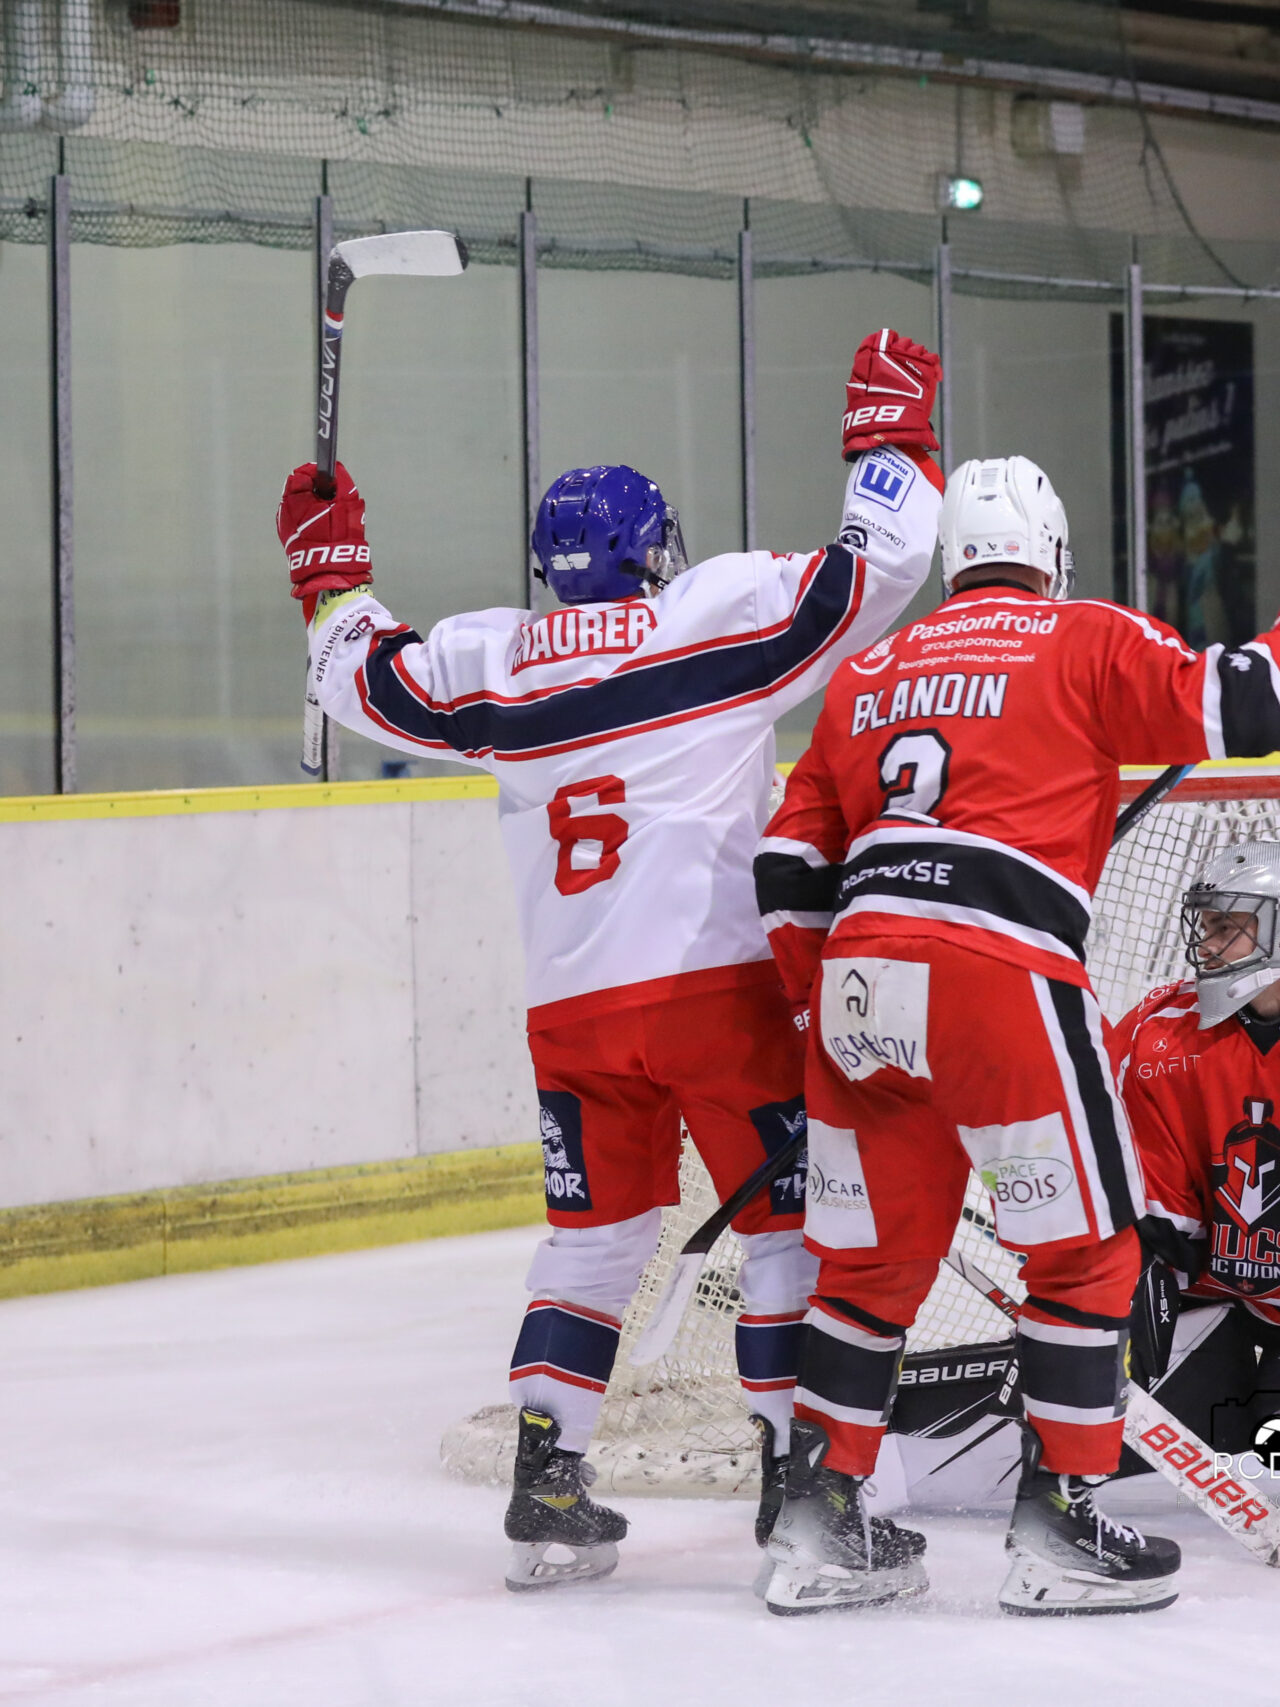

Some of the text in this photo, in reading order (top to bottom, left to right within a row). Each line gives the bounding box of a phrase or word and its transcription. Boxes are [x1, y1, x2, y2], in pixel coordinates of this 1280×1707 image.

[907, 611, 1058, 642] PassionFroid
[897, 652, 1035, 670] Bourgogne-Franche-Comté
[851, 673, 1008, 737] BLANDIN
[877, 728, 952, 827] 2
[546, 774, 629, 896] 6
[996, 1173, 1057, 1204] BOIS
